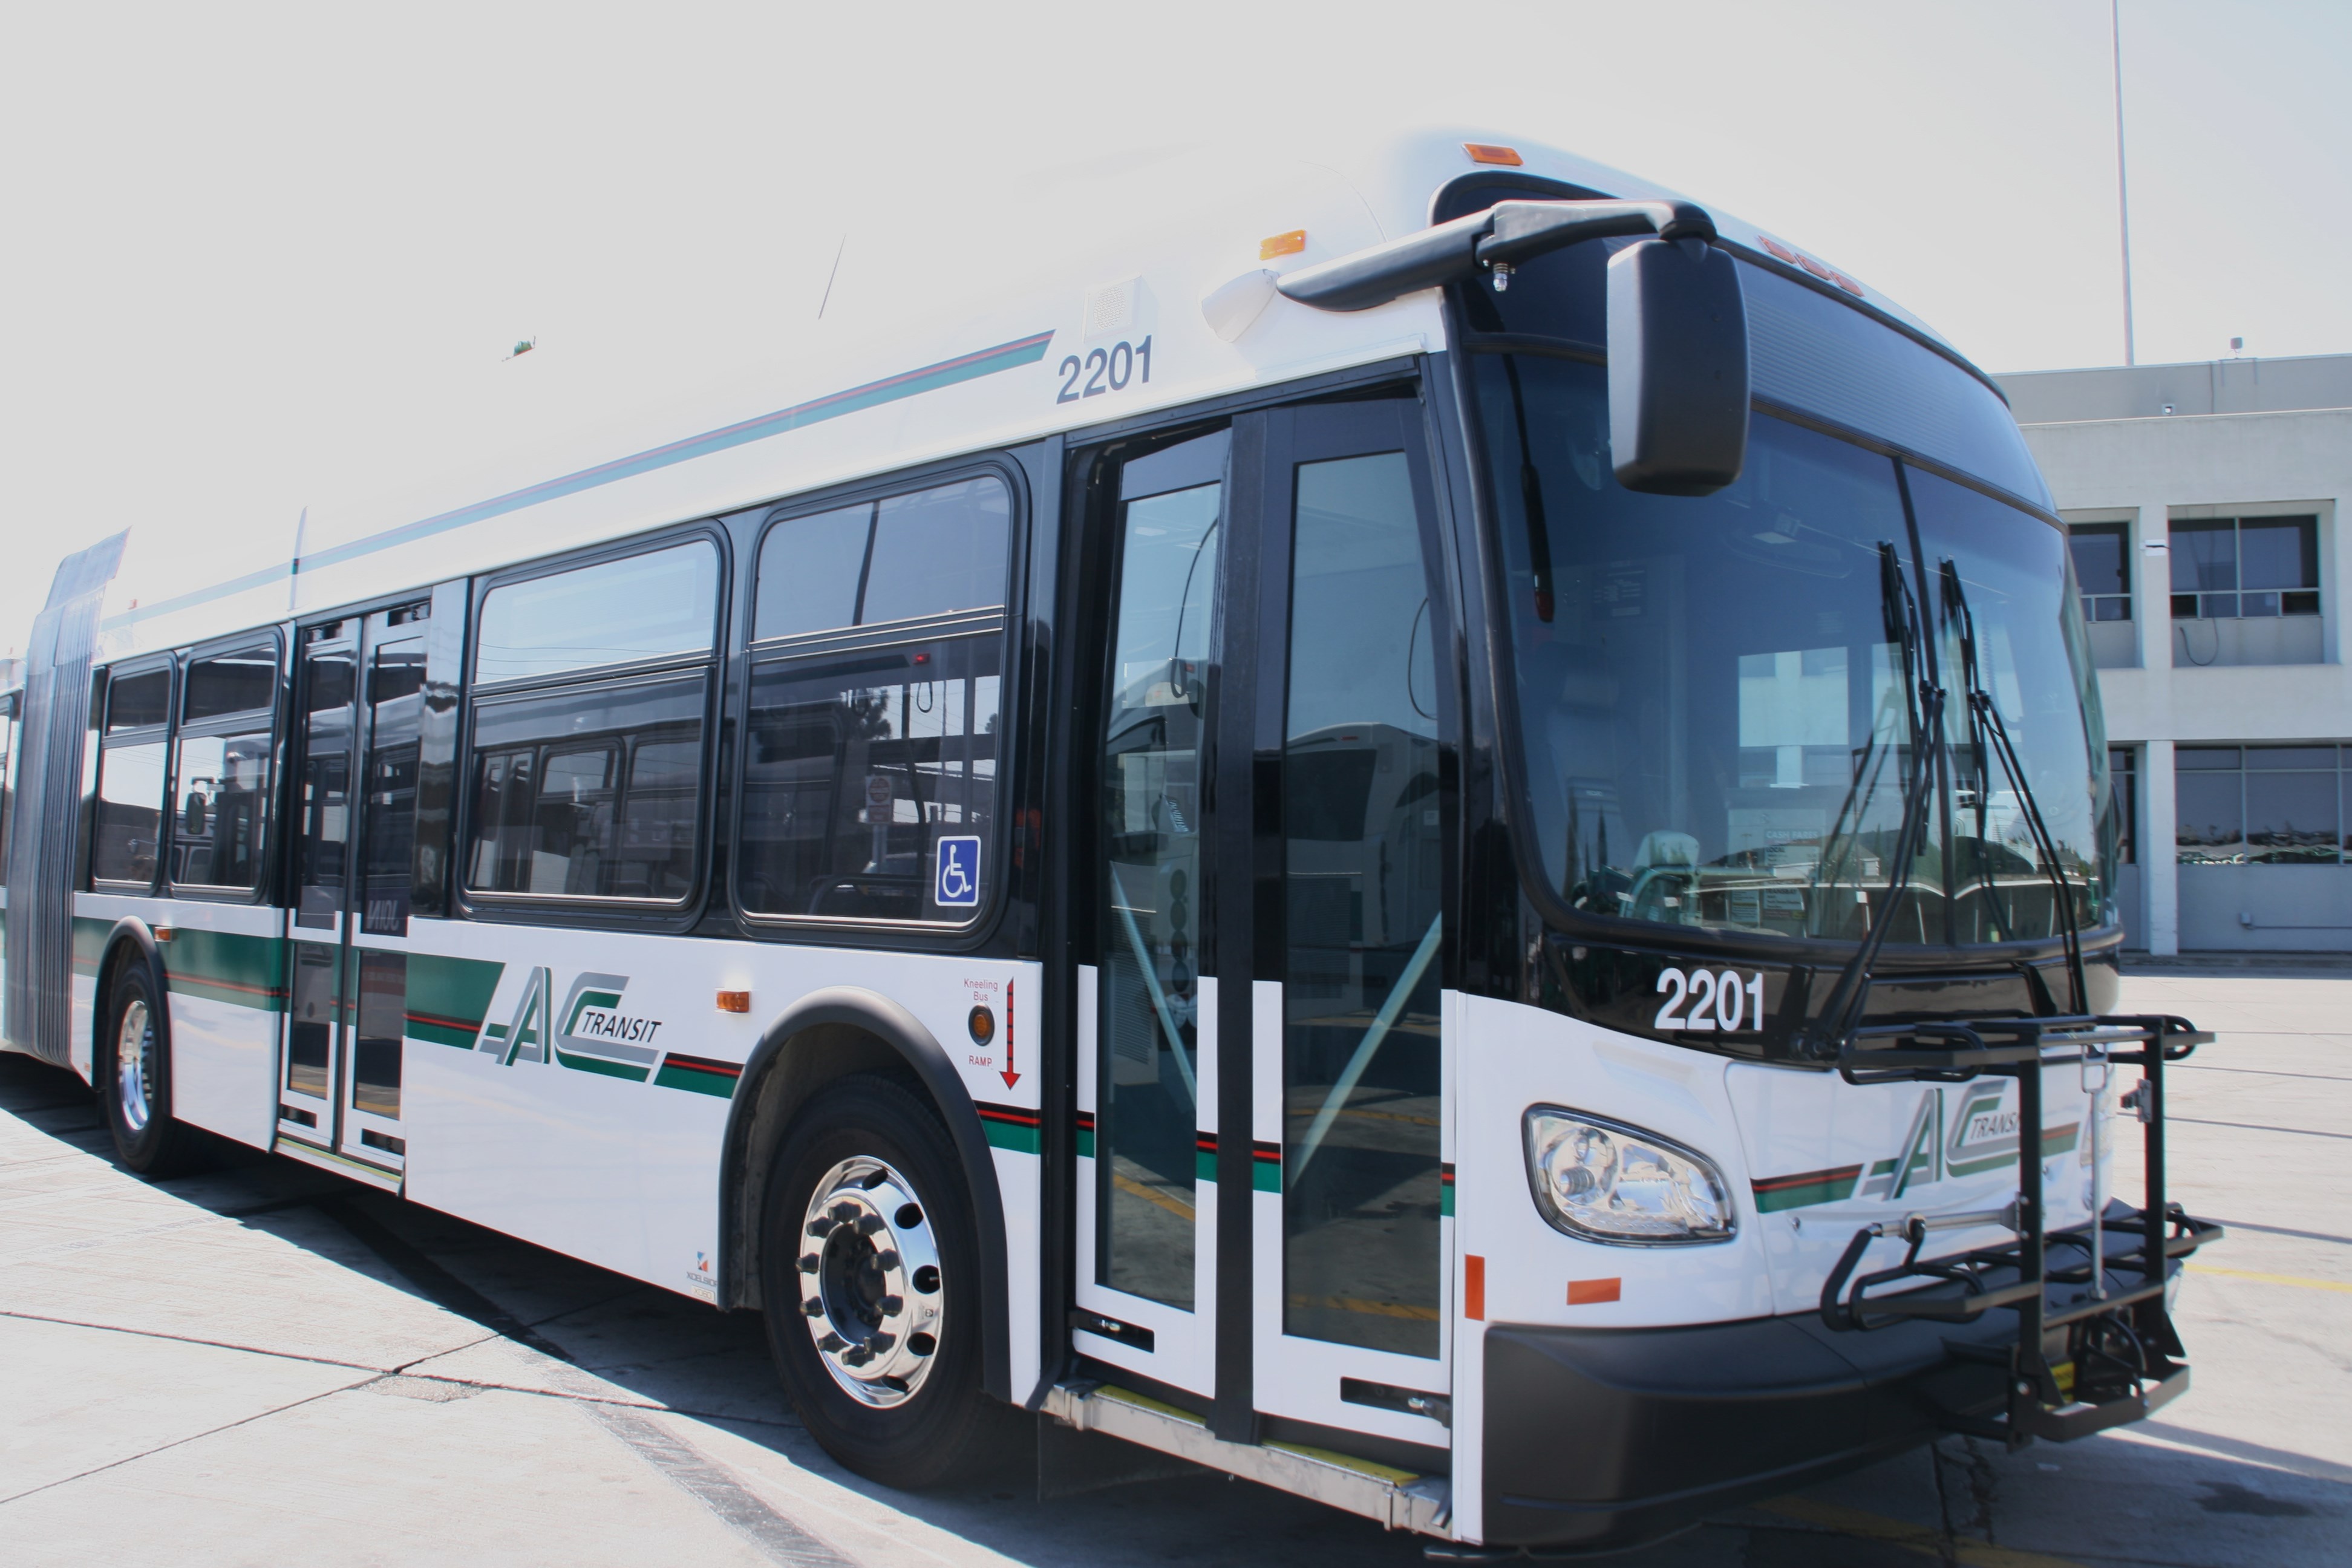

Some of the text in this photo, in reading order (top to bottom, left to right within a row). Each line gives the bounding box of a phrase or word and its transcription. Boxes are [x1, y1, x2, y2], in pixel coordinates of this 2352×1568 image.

[1056, 335, 1152, 404] 2201
[964, 978, 998, 991] Kneeling
[973, 991, 988, 1001] Bus
[1655, 967, 1763, 1031] 2201
[479, 966, 662, 1083] AC TRANSIT
[969, 1055, 993, 1067] RAMP
[1861, 1079, 2020, 1201] AC TRANSI
